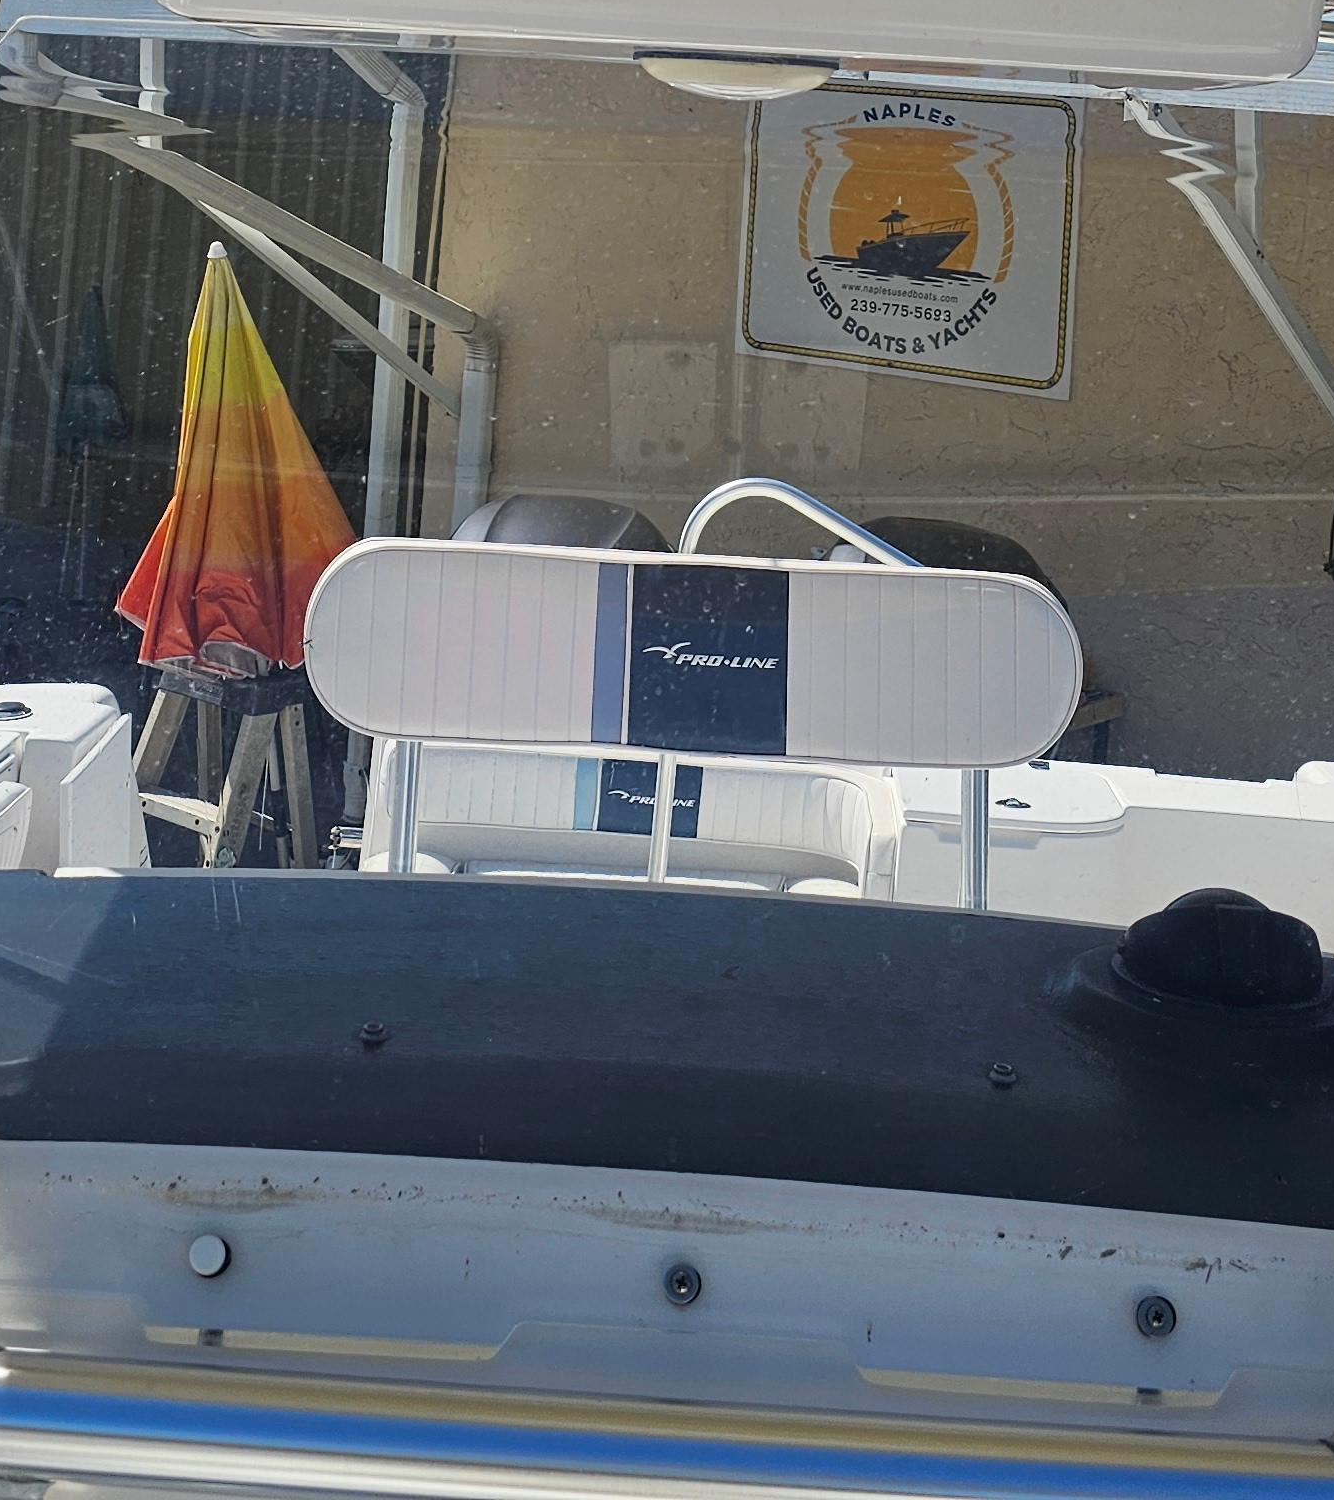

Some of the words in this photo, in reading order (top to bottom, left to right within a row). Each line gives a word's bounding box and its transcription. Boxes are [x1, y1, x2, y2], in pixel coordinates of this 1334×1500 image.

[863, 102, 956, 127] NAPLES
[841, 282, 959, 304] www.naplesusedboats.com
[806, 266, 843, 320] USED
[841, 315, 907, 355] BOATS
[911, 336, 925, 354] &
[927, 287, 997, 350] YACHTS
